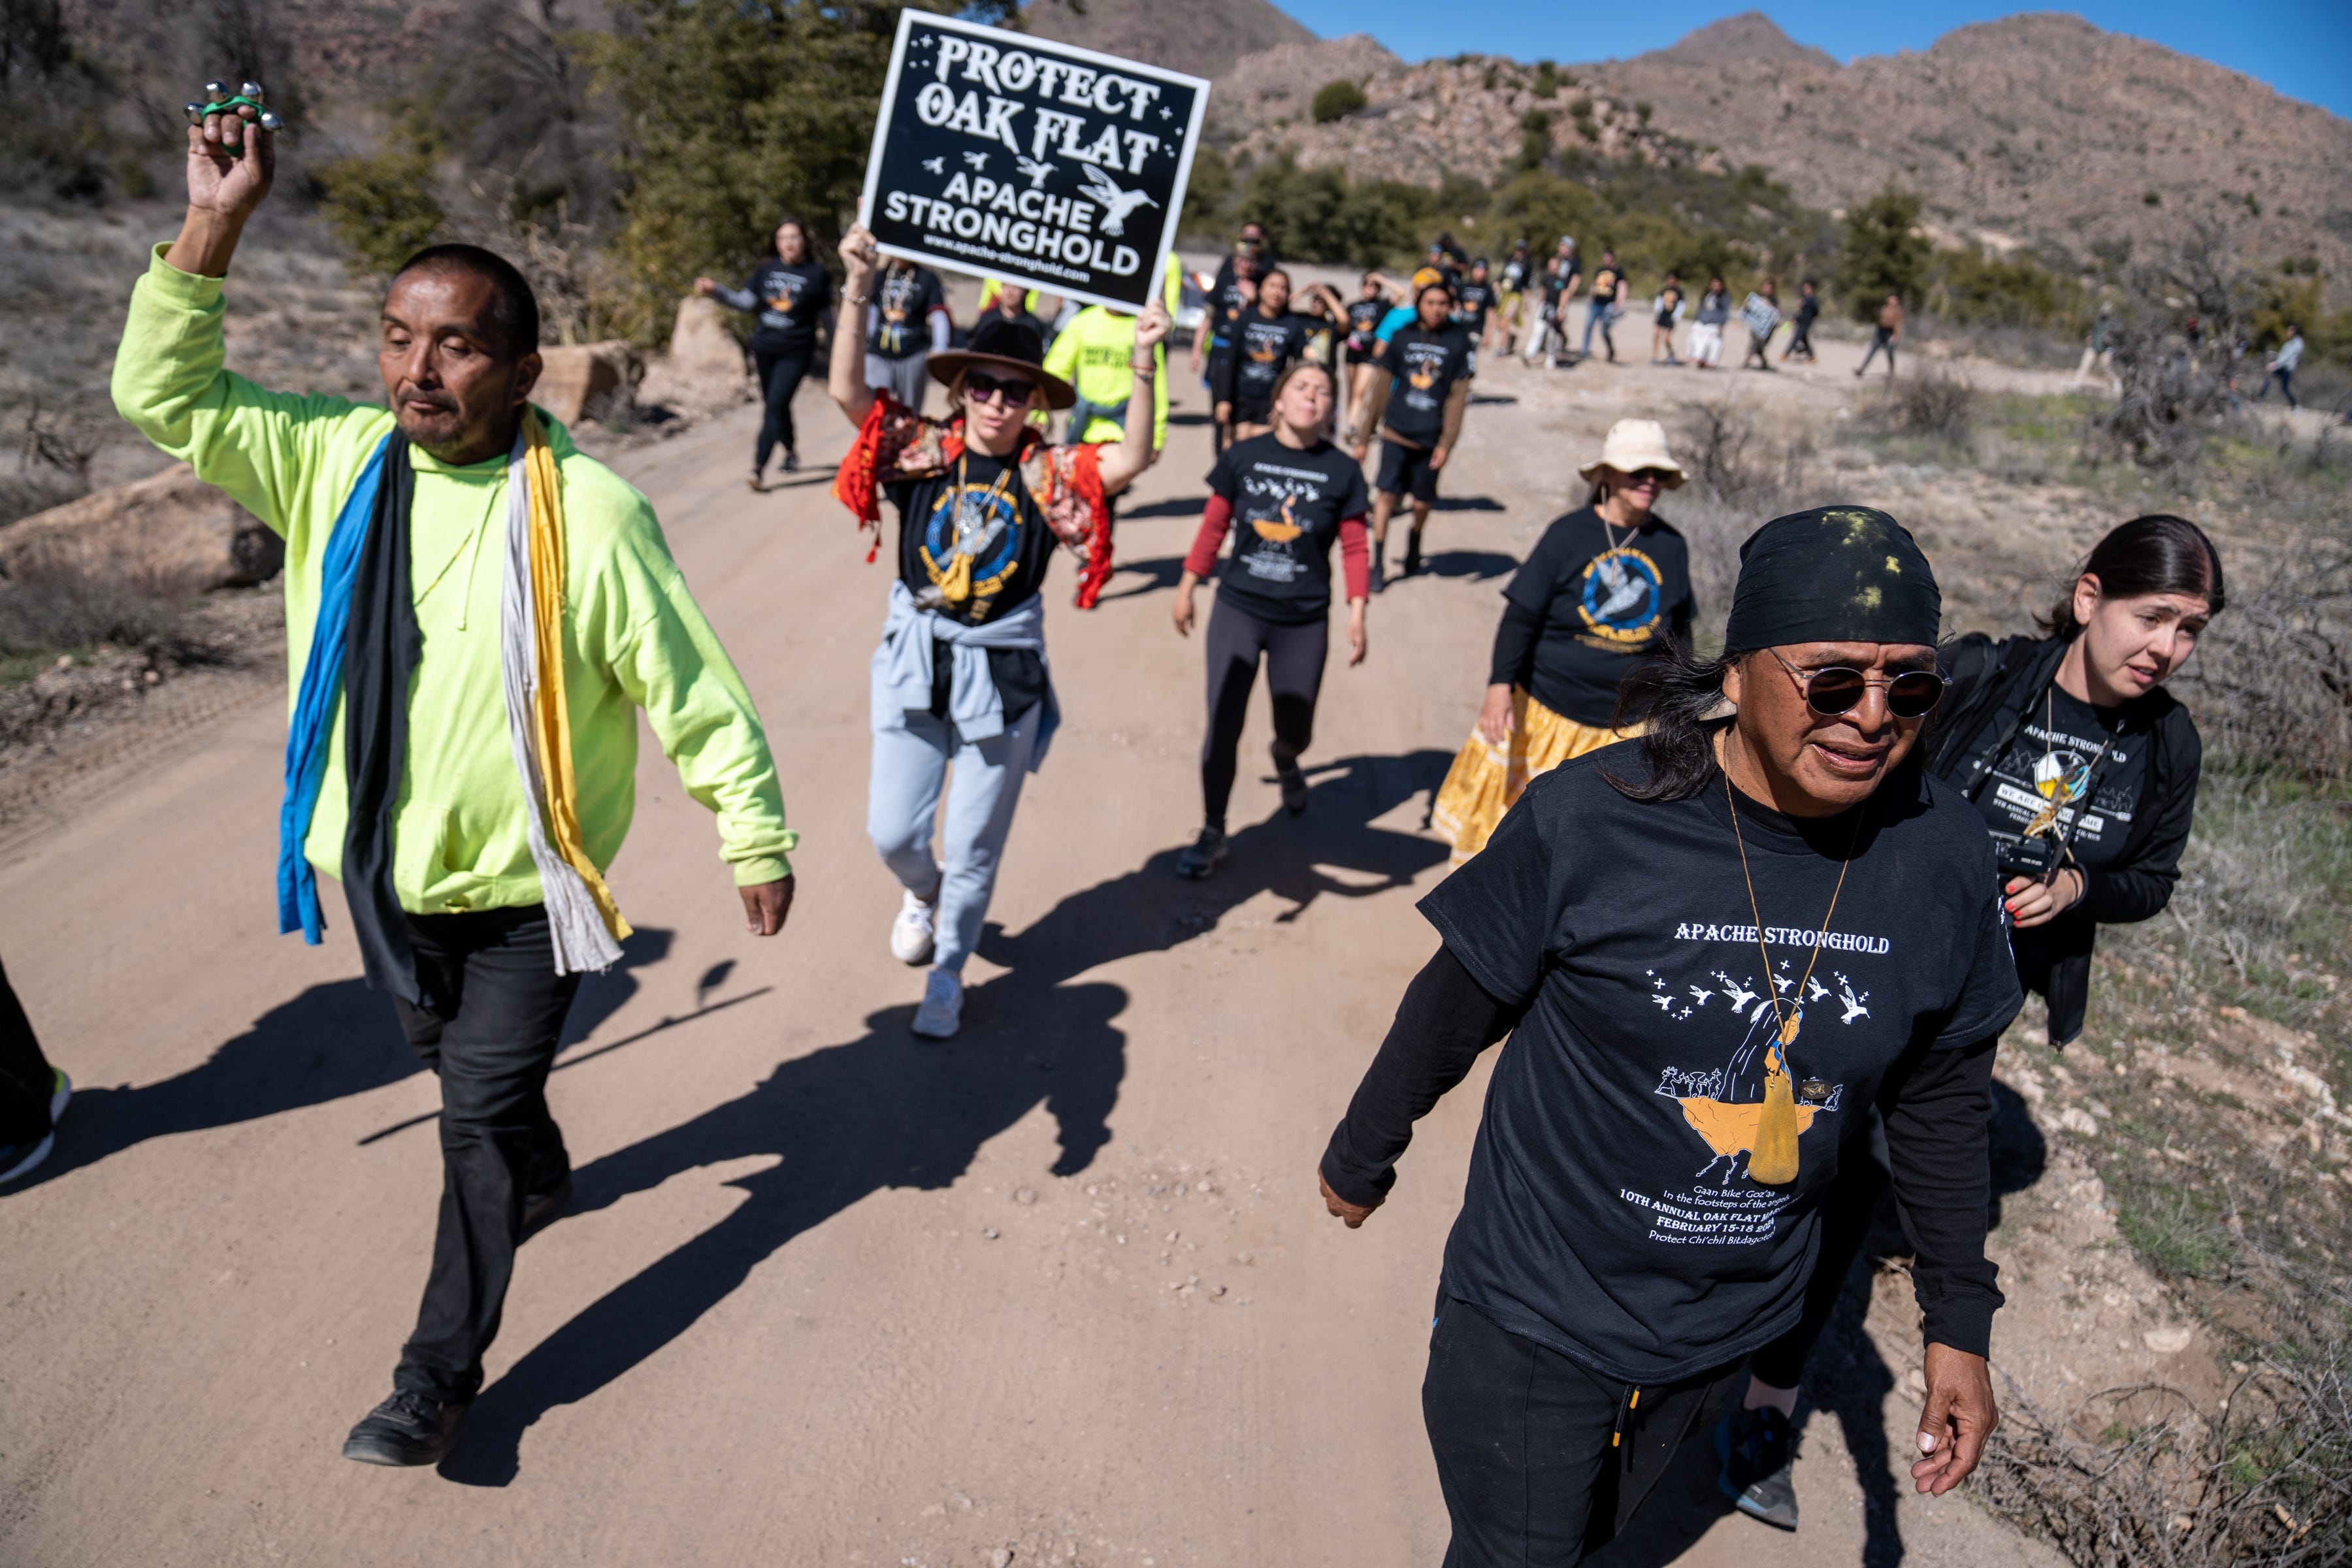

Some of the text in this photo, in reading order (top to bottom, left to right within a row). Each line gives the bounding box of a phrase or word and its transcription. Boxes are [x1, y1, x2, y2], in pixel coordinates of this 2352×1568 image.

[935, 35, 1161, 120] PROTECT
[915, 82, 1159, 174] OAK FLAT
[942, 172, 1095, 232] APACHE
[884, 191, 1139, 276] STRONGHOLD
[923, 234, 1090, 283] www.apache-stronghold.com
[2025, 725, 2068, 744] APACHE
[1674, 923, 1891, 955] APACHE STRONGHOLD
[1620, 1188, 1761, 1222] 10TH ANNUAL OAK FLAT
[1663, 1190, 1791, 1209] In the footsteps of the angels
[1693, 1186, 1775, 1198] Gaan Bike' Goz'aa
[1648, 1230, 1686, 1244] Protect
[1688, 1234, 1725, 1245] Chi'chil
[1656, 1216, 1722, 1233] FEBRUARY
[1723, 1224, 1754, 1232] 15-18
